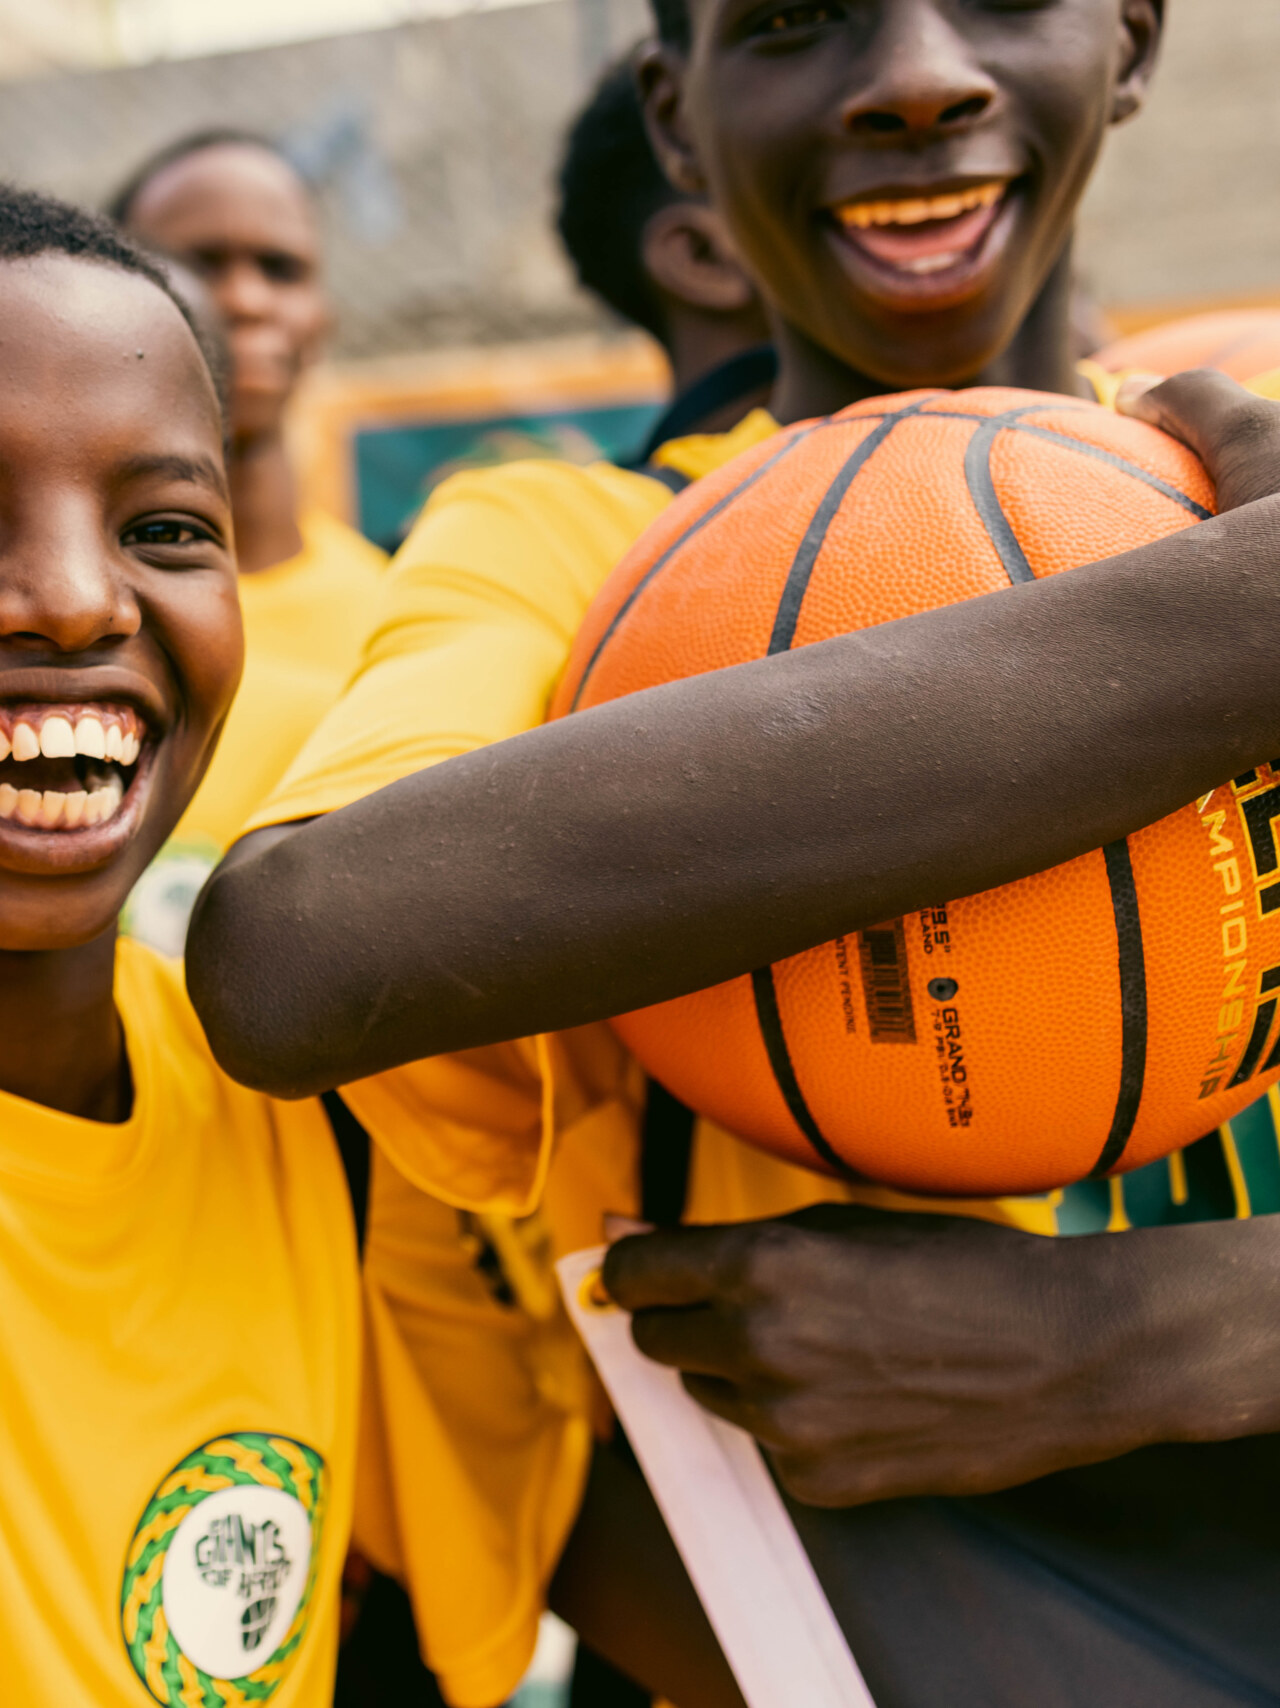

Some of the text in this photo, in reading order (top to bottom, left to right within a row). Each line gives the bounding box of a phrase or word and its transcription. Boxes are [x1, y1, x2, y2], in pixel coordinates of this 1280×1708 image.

[835, 936, 849, 977] ATENT
[920, 909, 933, 954] ILAND
[1196, 789, 1248, 1100] MPIONSHIP
[943, 1007, 967, 1084] GRAND
